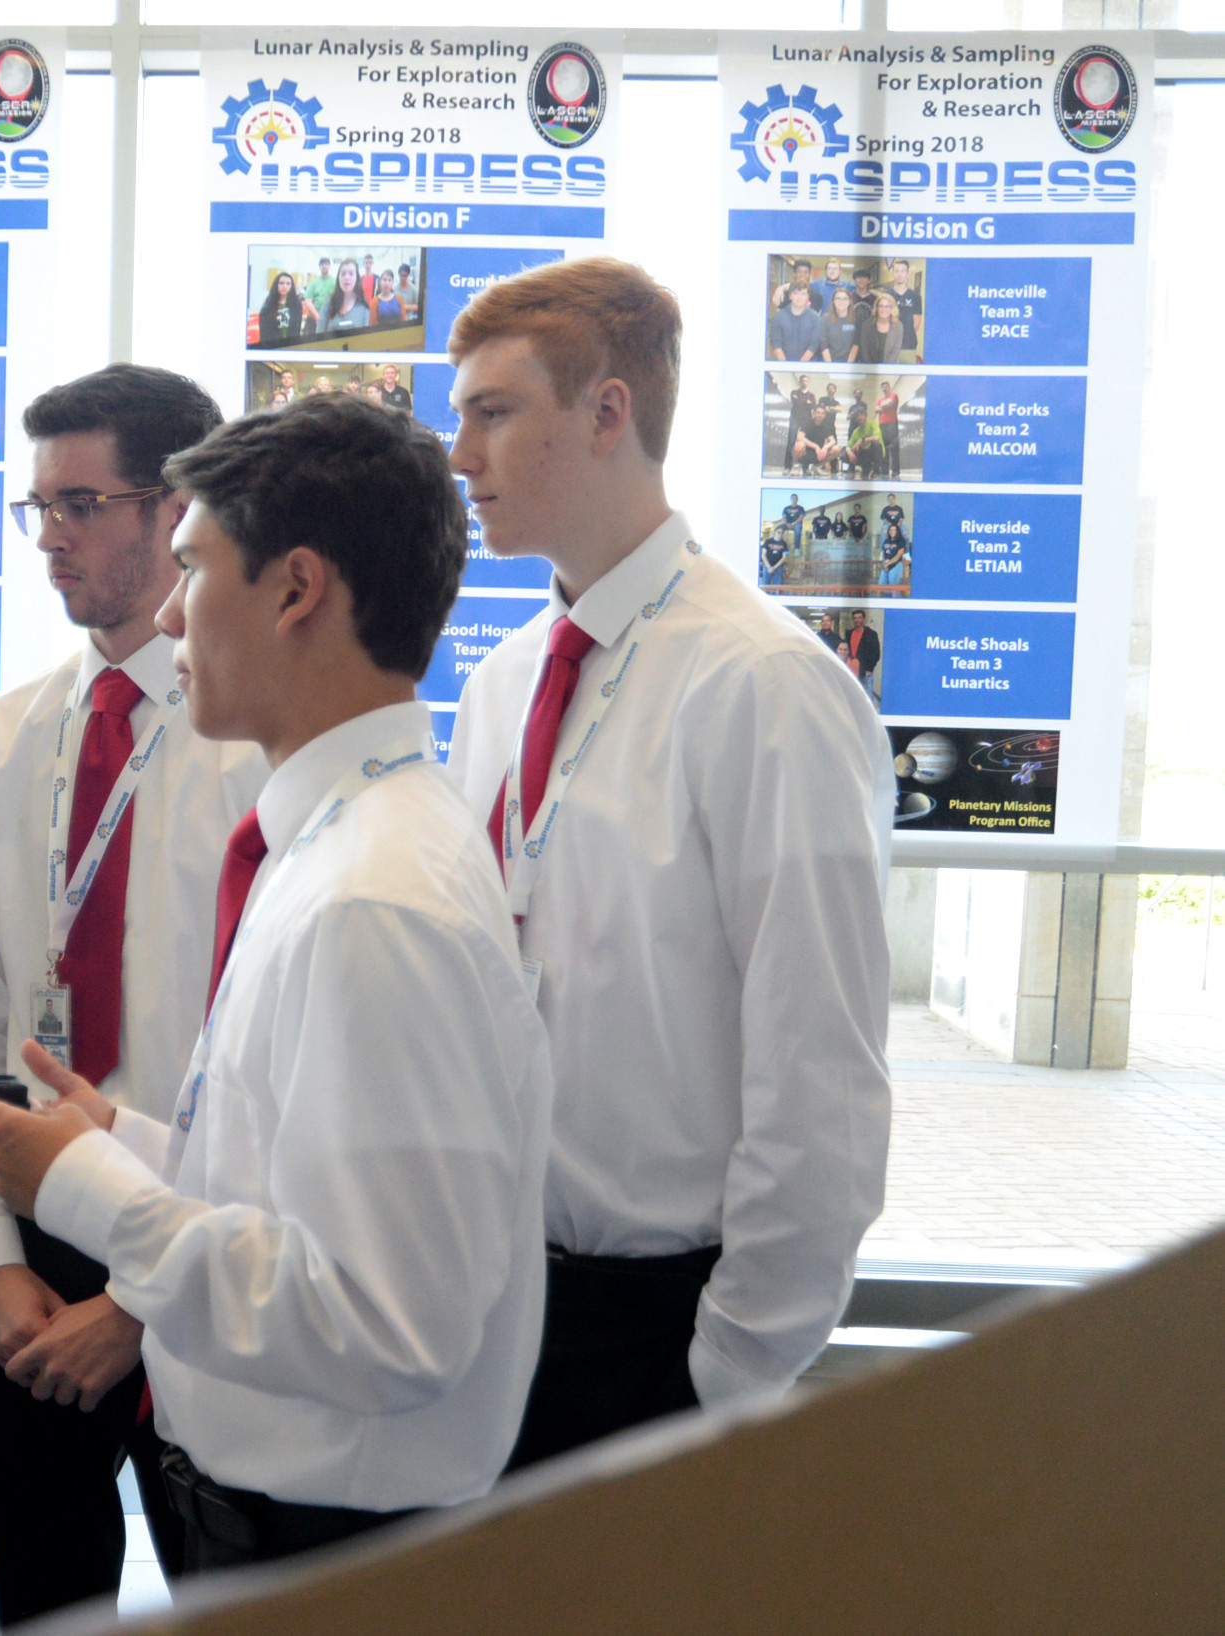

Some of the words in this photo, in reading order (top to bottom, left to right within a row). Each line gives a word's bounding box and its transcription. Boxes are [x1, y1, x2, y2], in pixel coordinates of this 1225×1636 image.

[253, 39, 313, 56] Lunar
[319, 39, 404, 59] Analysis
[410, 41, 425, 57] &
[430, 40, 529, 61] Sampling
[772, 44, 833, 61] Lunar
[838, 45, 925, 66] Analysis
[930, 47, 946, 63] &
[952, 46, 1056, 67] Sampling
[358, 67, 390, 83] For
[396, 66, 517, 87] Exploration
[877, 74, 911, 91] For
[917, 74, 1043, 95] Exploration
[402, 93, 417, 109] &
[422, 92, 516, 110] Research
[922, 101, 938, 117] &
[944, 100, 1041, 118] Research
[336, 126, 404, 147] Spring
[411, 127, 462, 144] 2018
[855, 135, 925, 156] Spring
[931, 135, 985, 153] 2018
[343, 206, 449, 229] Division
[456, 208, 471, 229] F
[861, 214, 969, 240] Division
[975, 216, 995, 240] G
[968, 285, 1047, 299] Hanceville
[979, 305, 1019, 319] Team
[1024, 305, 1033, 319] 3
[981, 324, 1030, 339] SPACE
[958, 402, 1004, 417] Grand
[1008, 403, 1050, 417] Forks
[976, 423, 1016, 436] Team
[1020, 423, 1029, 437] 2
[967, 442, 1037, 456] MALCOM
[960, 520, 1030, 535] Riverside
[968, 540, 1007, 554] Team
[1011, 541, 1021, 554] 2
[965, 559, 1022, 574] LETIAM
[453, 642, 492, 656] Team
[926, 636, 978, 651] Muscle
[980, 637, 1030, 651] Shoals
[950, 656, 990, 670] Team
[993, 657, 1003, 671] 3
[941, 675, 1010, 690] Lunartics
[949, 799, 1002, 813] Planetary
[1003, 800, 1052, 812] Missions
[969, 815, 1016, 828] Program
[1018, 816, 1051, 828] Office
